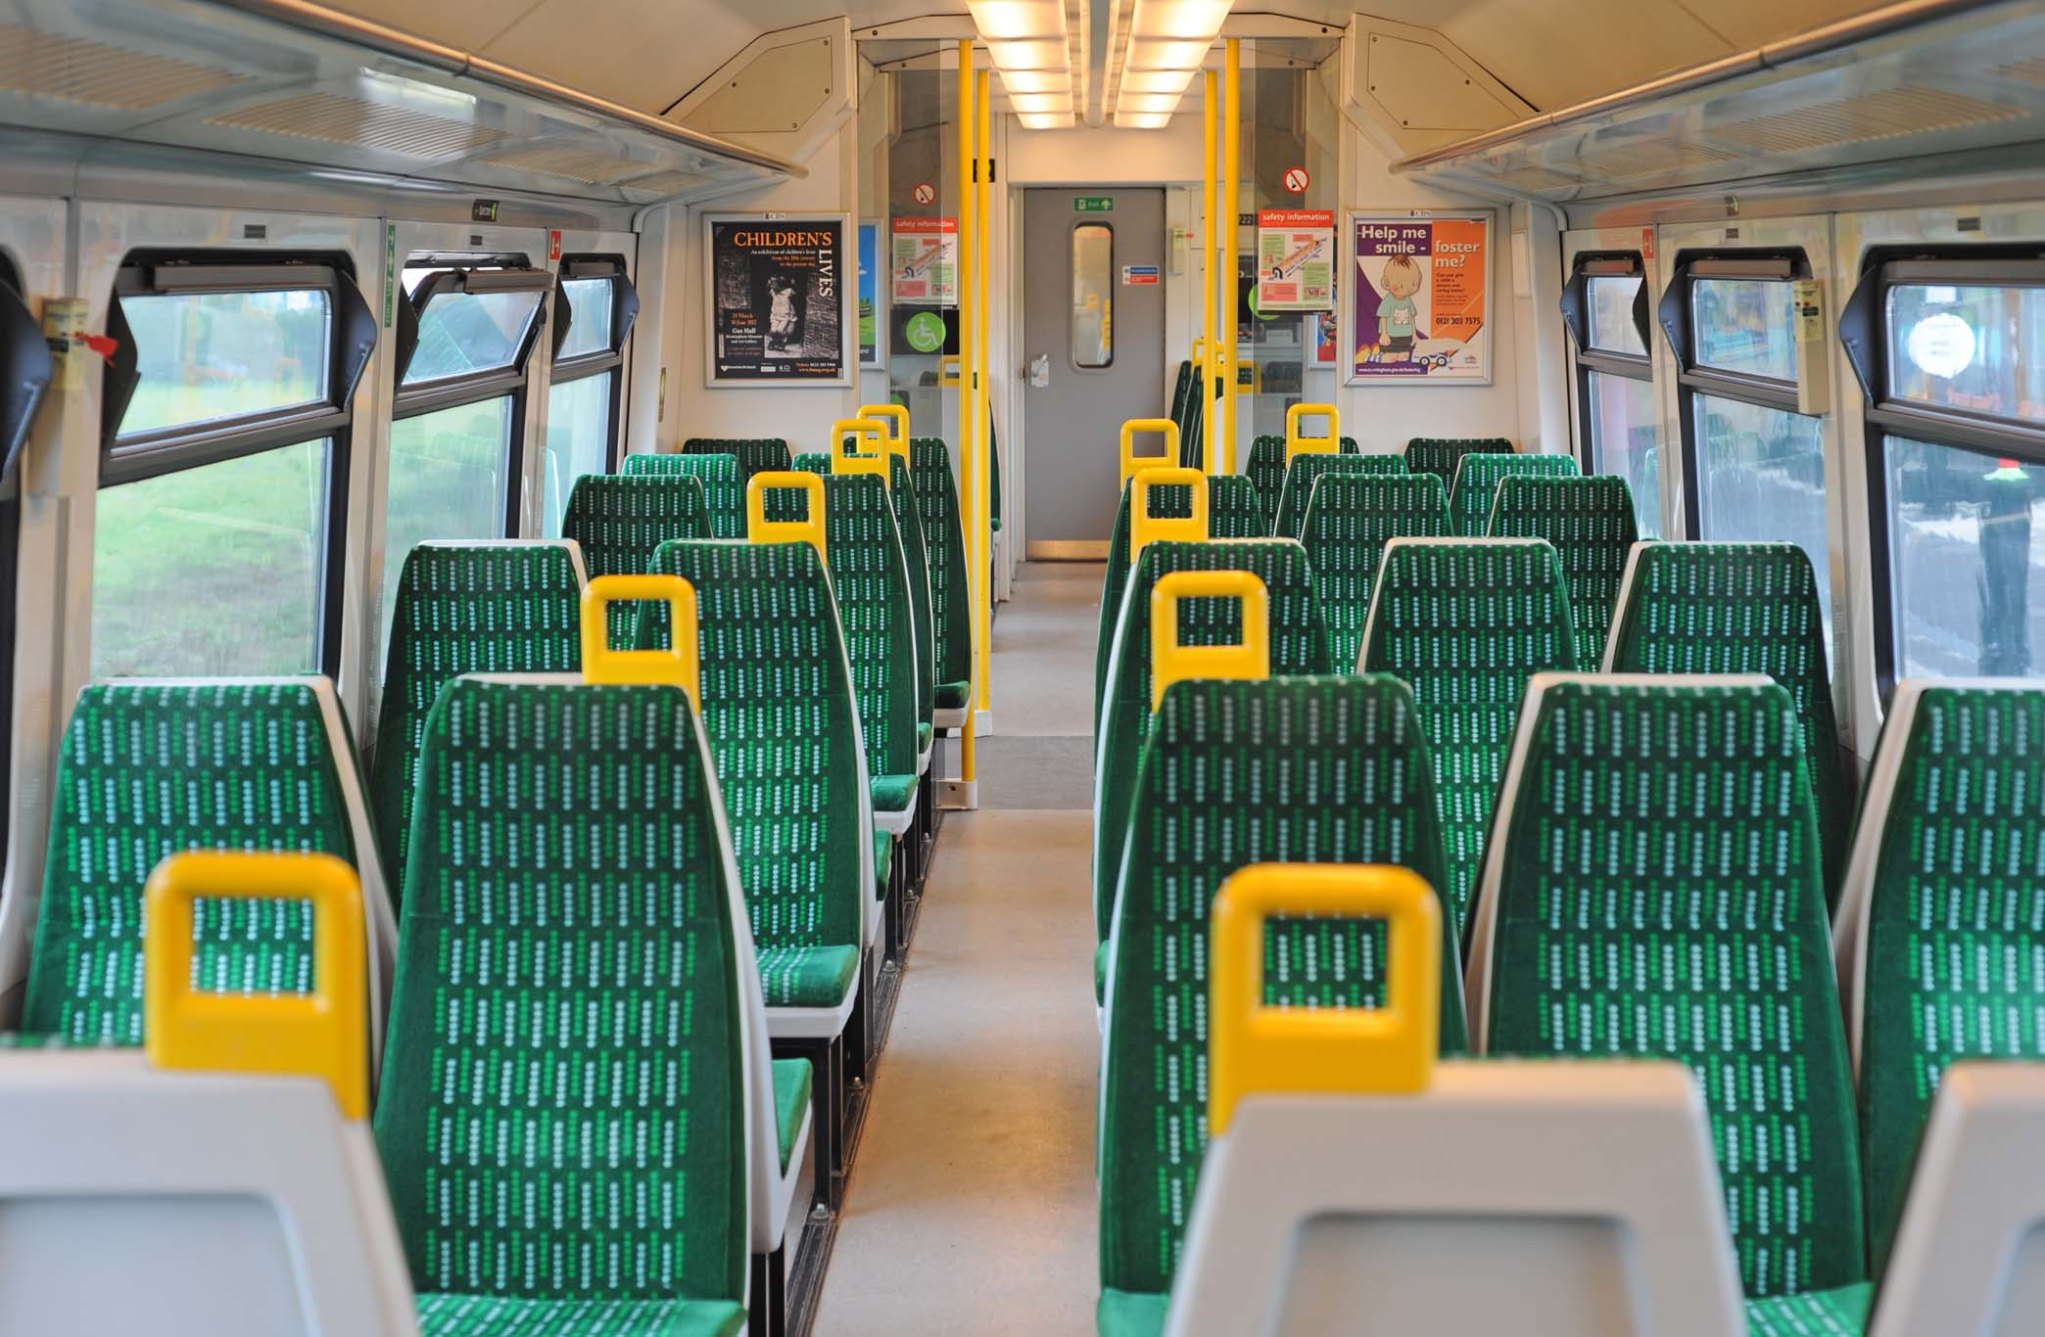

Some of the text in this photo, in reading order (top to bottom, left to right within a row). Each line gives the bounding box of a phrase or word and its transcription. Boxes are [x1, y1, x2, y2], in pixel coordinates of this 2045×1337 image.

[1263, 213, 1330, 222] safety information
[734, 231, 832, 246] CHILDREN'S
[1361, 225, 1427, 242] Help me
[1375, 241, 1416, 254] smile
[1435, 240, 1480, 254] foster
[1435, 254, 1466, 268] me?
[818, 249, 833, 297] LIVES
[1436, 316, 1481, 325] 0121 303 7575
